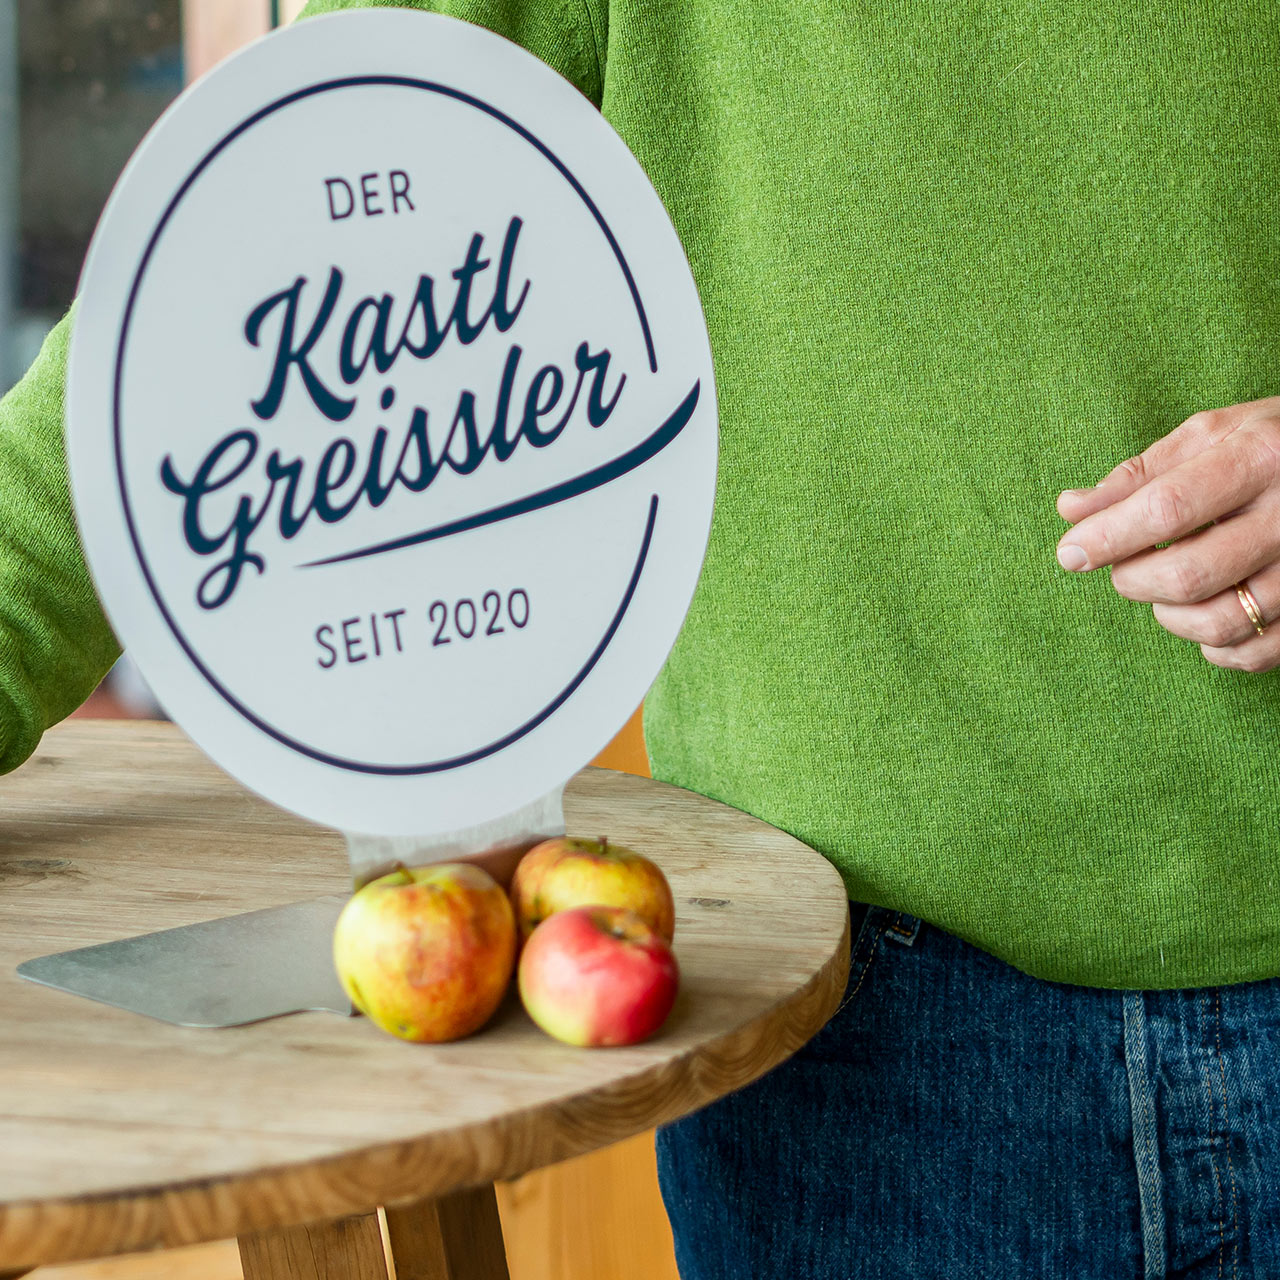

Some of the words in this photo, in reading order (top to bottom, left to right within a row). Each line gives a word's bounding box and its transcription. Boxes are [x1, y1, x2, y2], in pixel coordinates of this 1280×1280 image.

[324, 169, 416, 221] DER
[244, 216, 531, 422] Kastl
[160, 341, 627, 610] Greissler
[316, 608, 408, 670] SEIT
[430, 588, 532, 648] 2020
